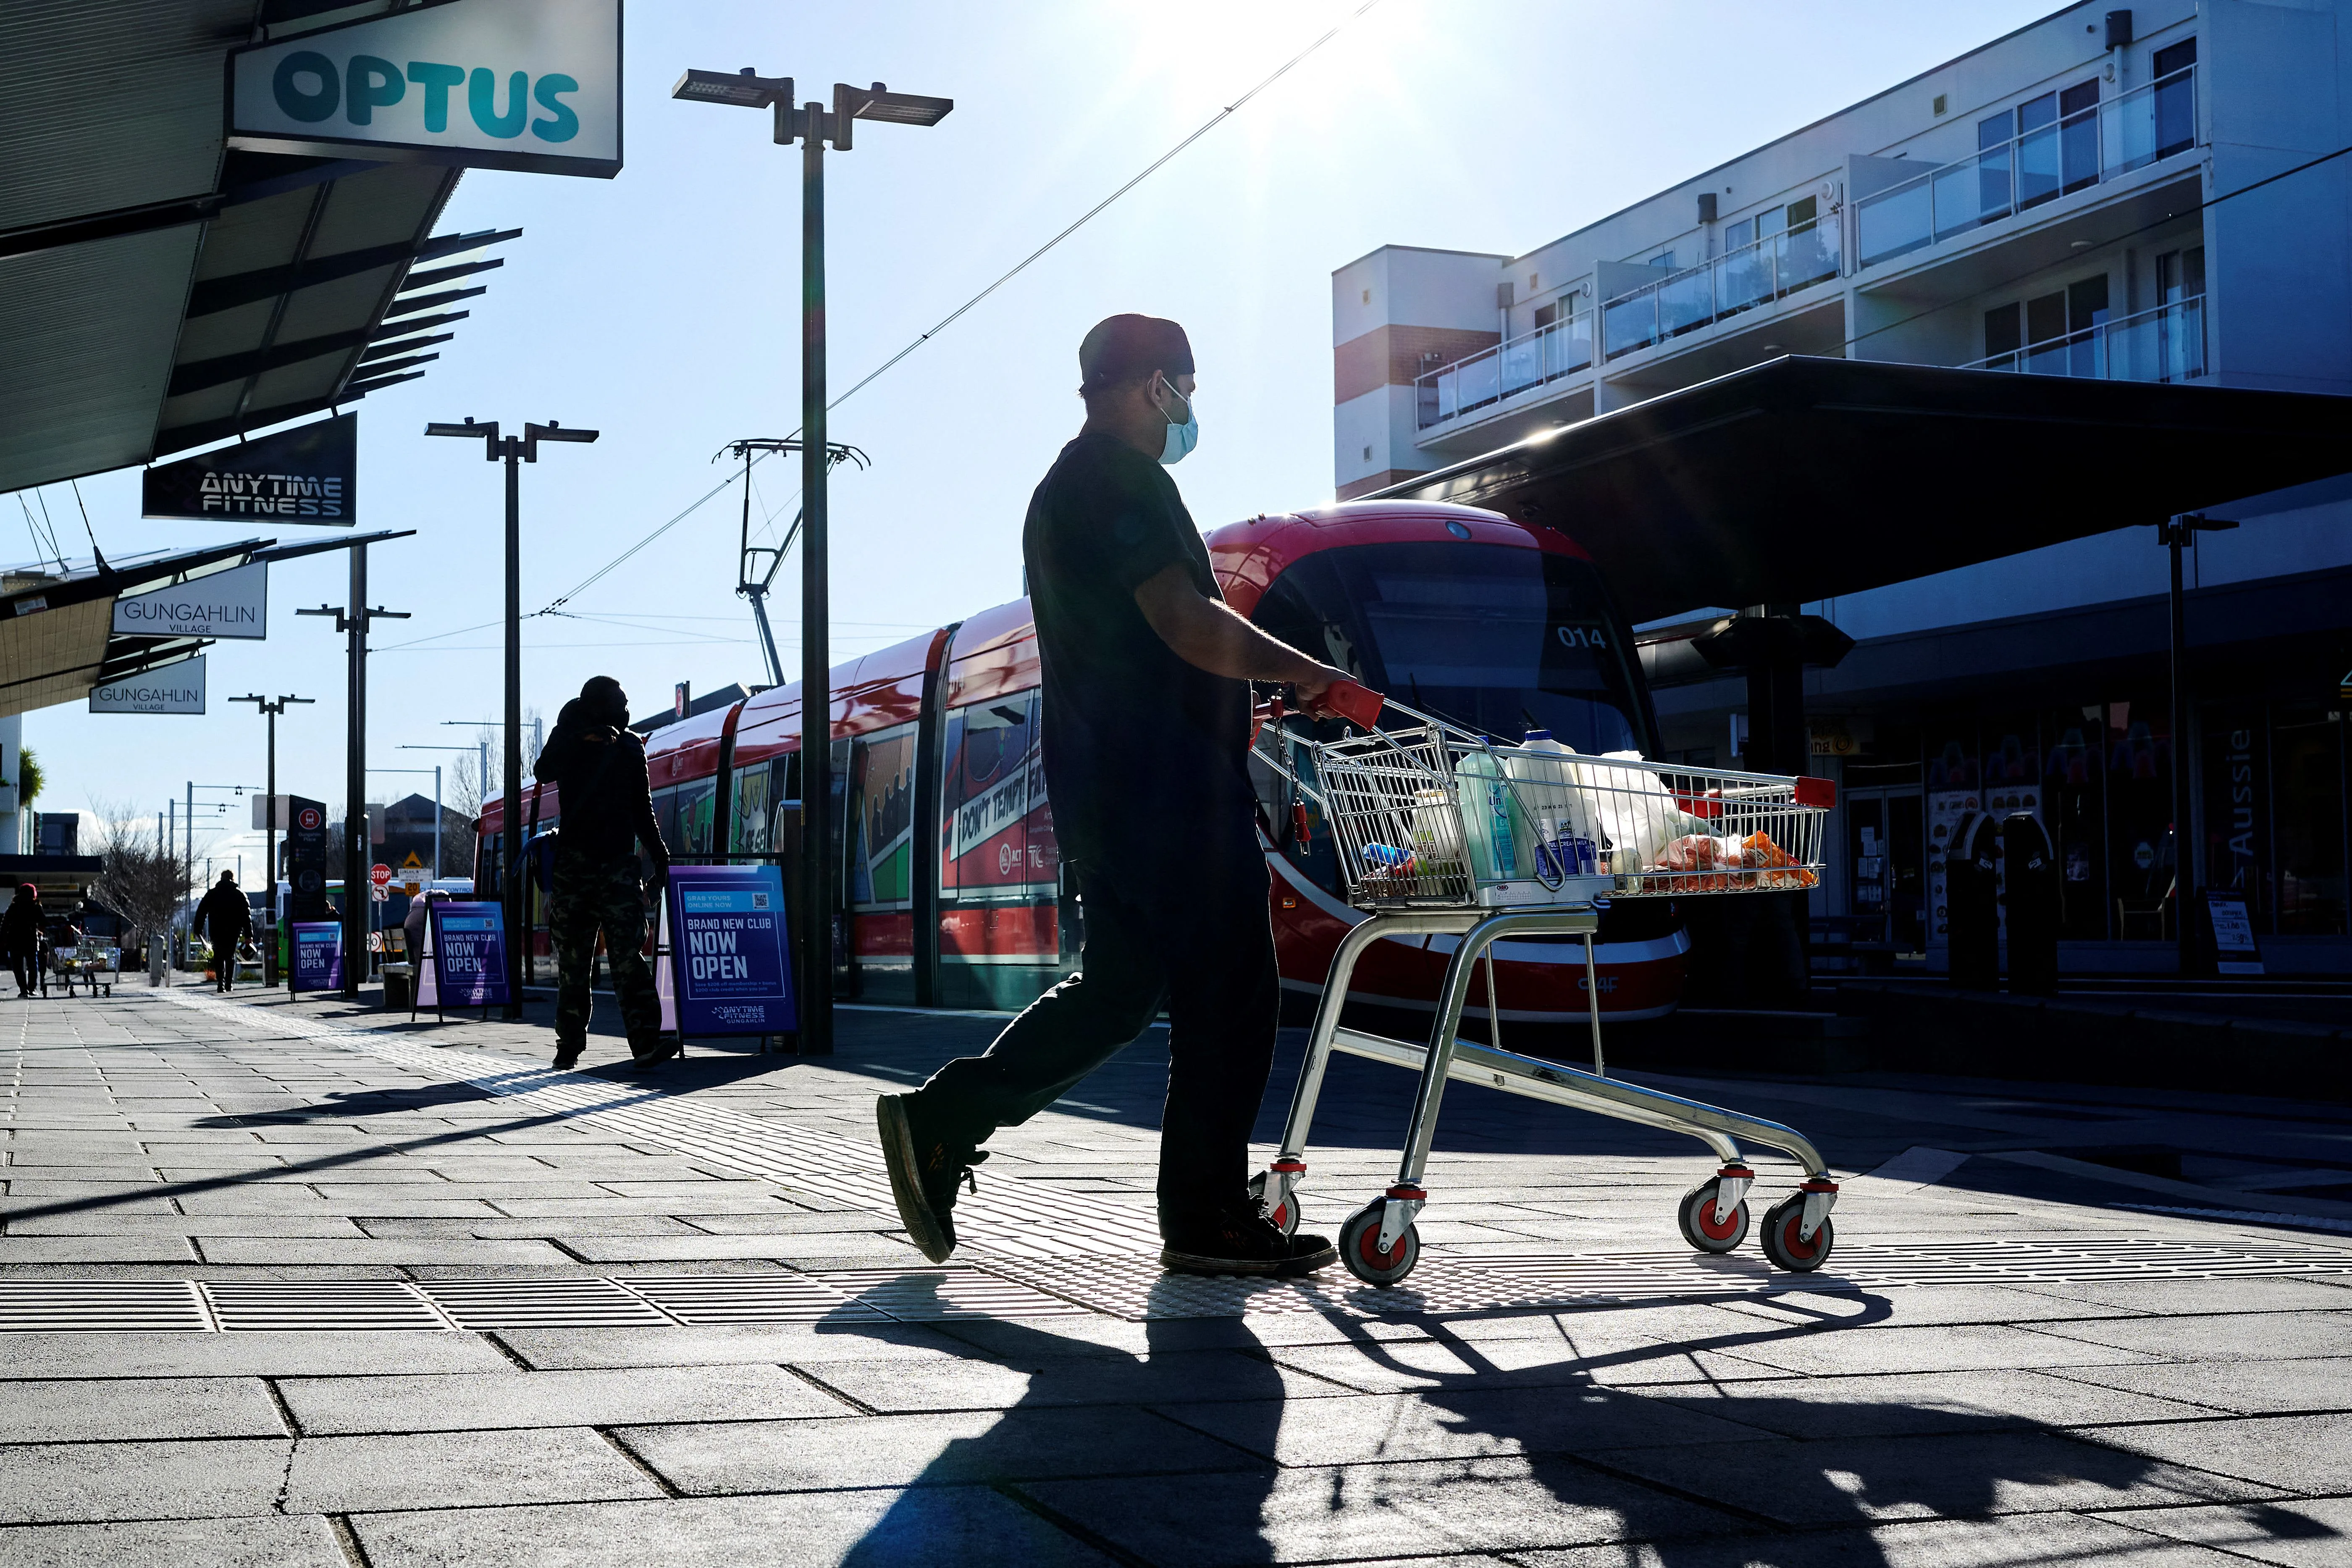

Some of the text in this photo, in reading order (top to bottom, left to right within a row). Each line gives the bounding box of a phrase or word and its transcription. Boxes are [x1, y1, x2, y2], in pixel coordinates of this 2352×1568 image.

[273, 51, 580, 143] OPTUS
[200, 472, 342, 498] ANYTIME
[203, 495, 342, 516] FITNESS
[124, 602, 255, 622] GUNGAHLIN
[169, 625, 211, 633] VILLAGE
[1557, 626, 1606, 649] 014
[99, 688, 197, 702] GUNGAHLIN
[2226, 729, 2254, 857] Aussie
[962, 796, 990, 842] DON'T
[1012, 849, 1022, 862] ACT
[688, 918, 771, 930] BRAND NEW CLUB
[445, 942, 474, 956] NOW
[689, 931, 736, 955] NOW
[300, 949, 321, 959] NOW
[301, 959, 325, 969] OPEN
[447, 958, 482, 972] OPEN
[692, 956, 748, 979] OPEN
